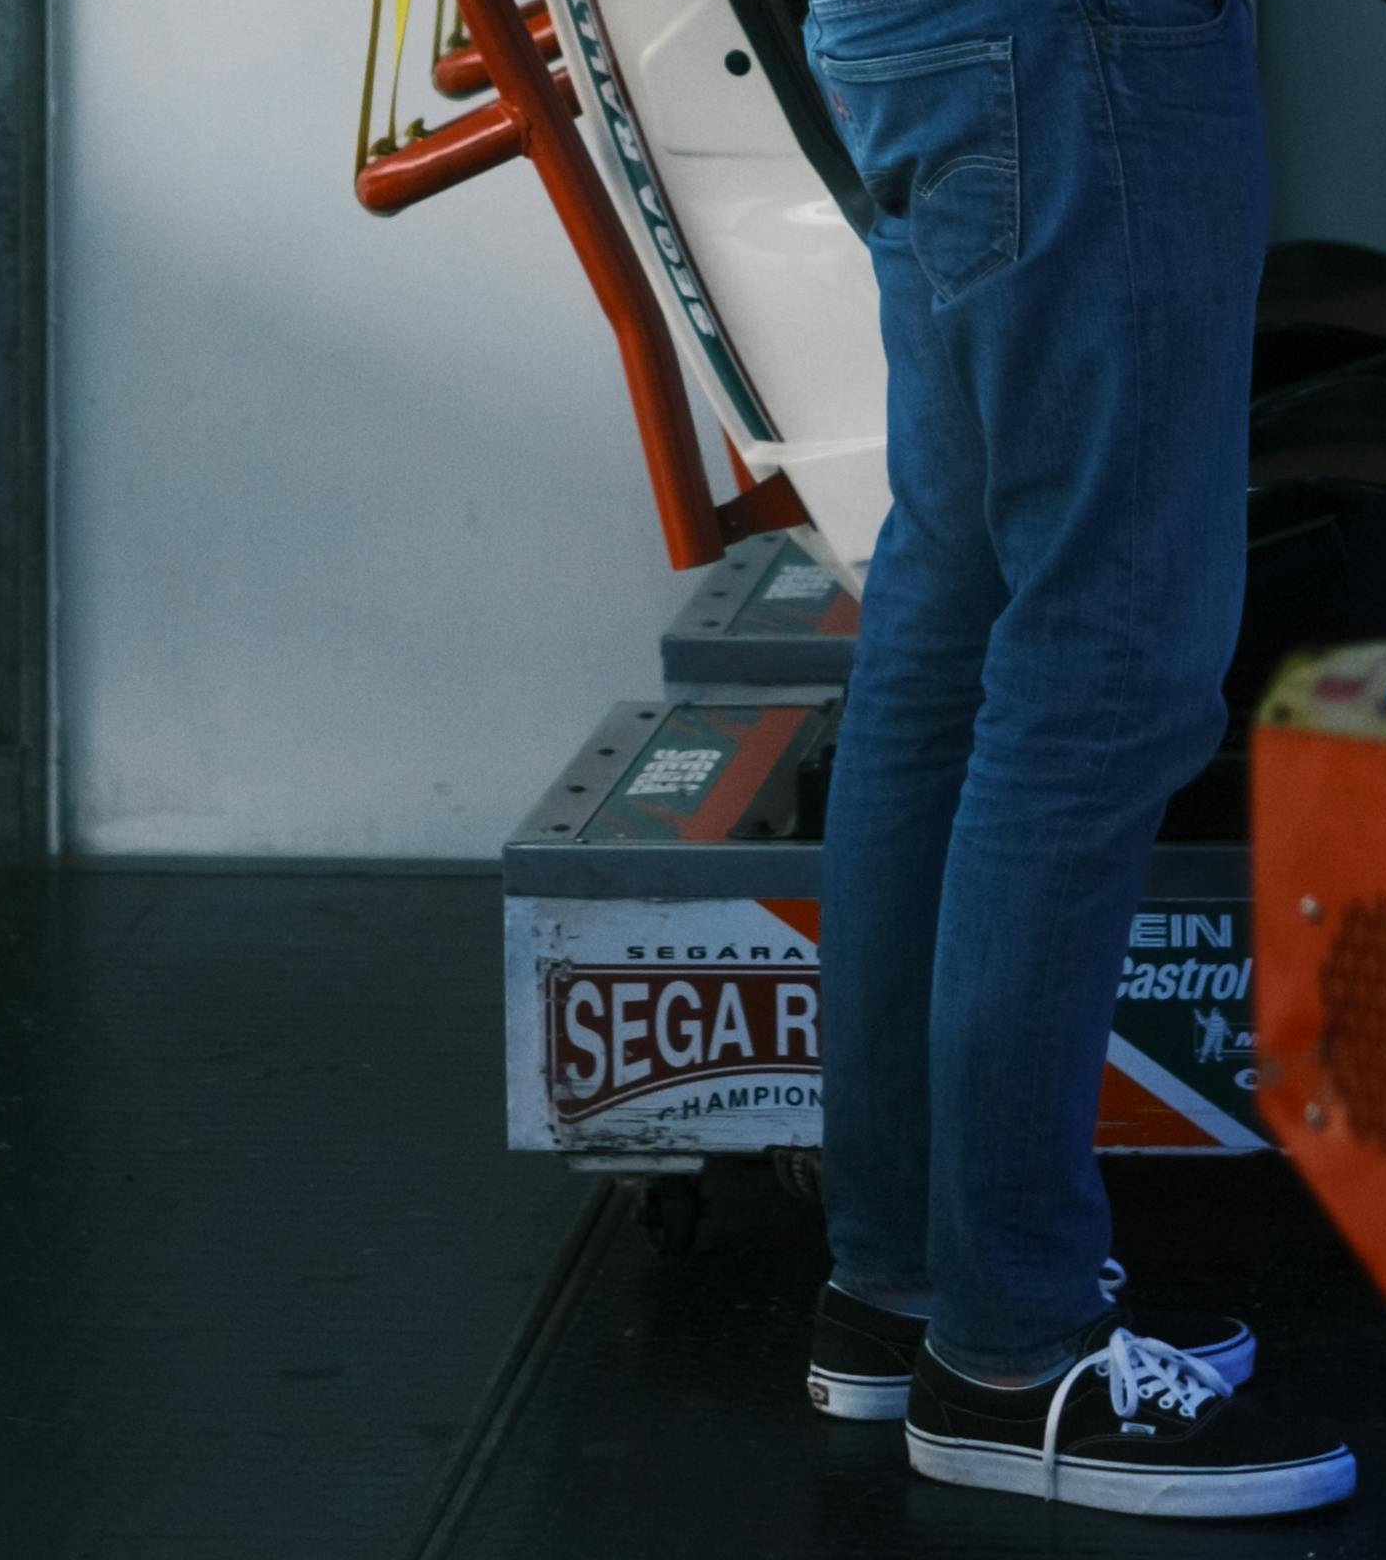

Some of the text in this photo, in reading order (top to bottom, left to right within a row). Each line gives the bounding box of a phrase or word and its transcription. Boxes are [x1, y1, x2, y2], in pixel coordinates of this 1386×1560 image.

[639, 184, 716, 338] SEGA
[626, 945, 821, 960] SEGARA
[564, 980, 754, 1099] SEGA
